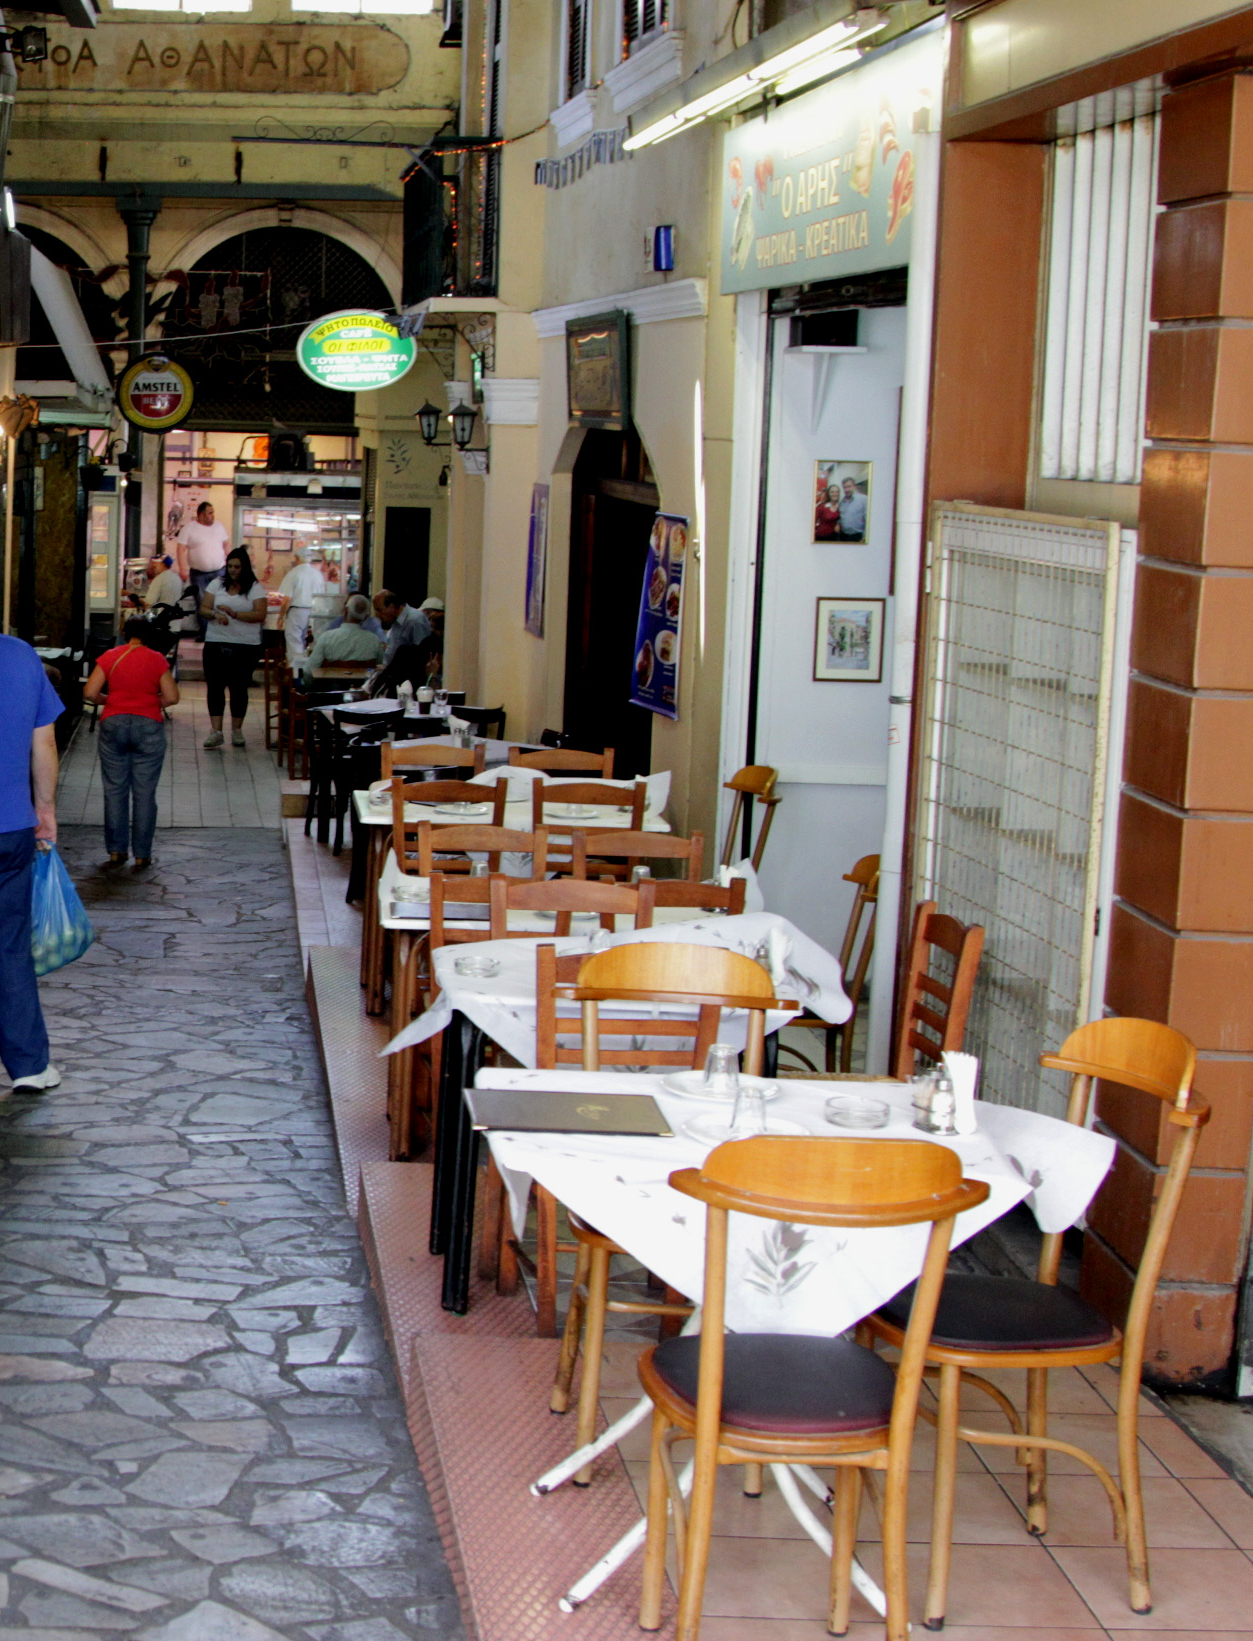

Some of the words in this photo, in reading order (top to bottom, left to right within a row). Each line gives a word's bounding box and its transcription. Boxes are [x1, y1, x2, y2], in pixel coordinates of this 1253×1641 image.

[127, 38, 356, 77] ΑΘΑΝΑΤΩΝ
[756, 228, 797, 269] ΨΑΡΙΚΑ
[805, 209, 869, 260] ΚΡΕΑΤΙΚΑ
[316, 317, 394, 337] ΨΗΤΟΠΩΛΕΙΟ
[346, 339, 384, 352] ΦΙΛΟΙ
[132, 382, 180, 393] AMSTEL
